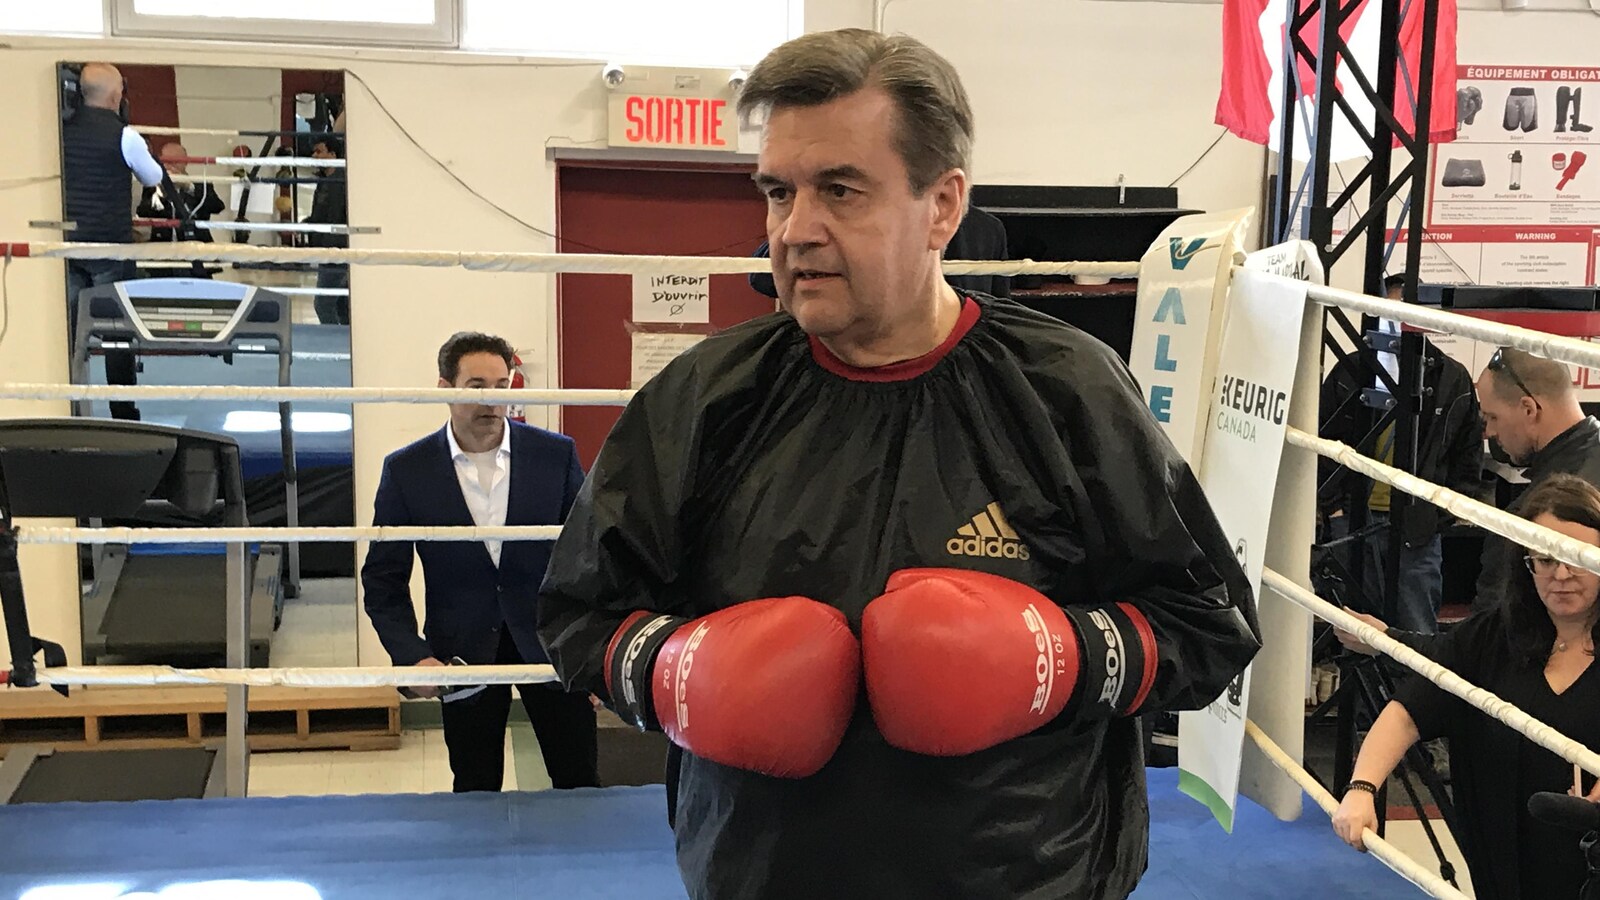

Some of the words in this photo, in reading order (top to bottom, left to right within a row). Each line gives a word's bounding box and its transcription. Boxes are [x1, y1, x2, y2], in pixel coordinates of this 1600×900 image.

[1467, 66, 1547, 79] ÉQUIPEMENT
[626, 96, 726, 145] SORTIE
[1515, 232, 1556, 240] WARNING
[1150, 237, 1208, 423] VALE
[1221, 374, 1286, 425] KEURIG
[1217, 411, 1256, 443] CANADA
[946, 534, 1030, 561] adidas
[1052, 633, 1064, 653] OZ
[1057, 658, 1065, 675] 12
